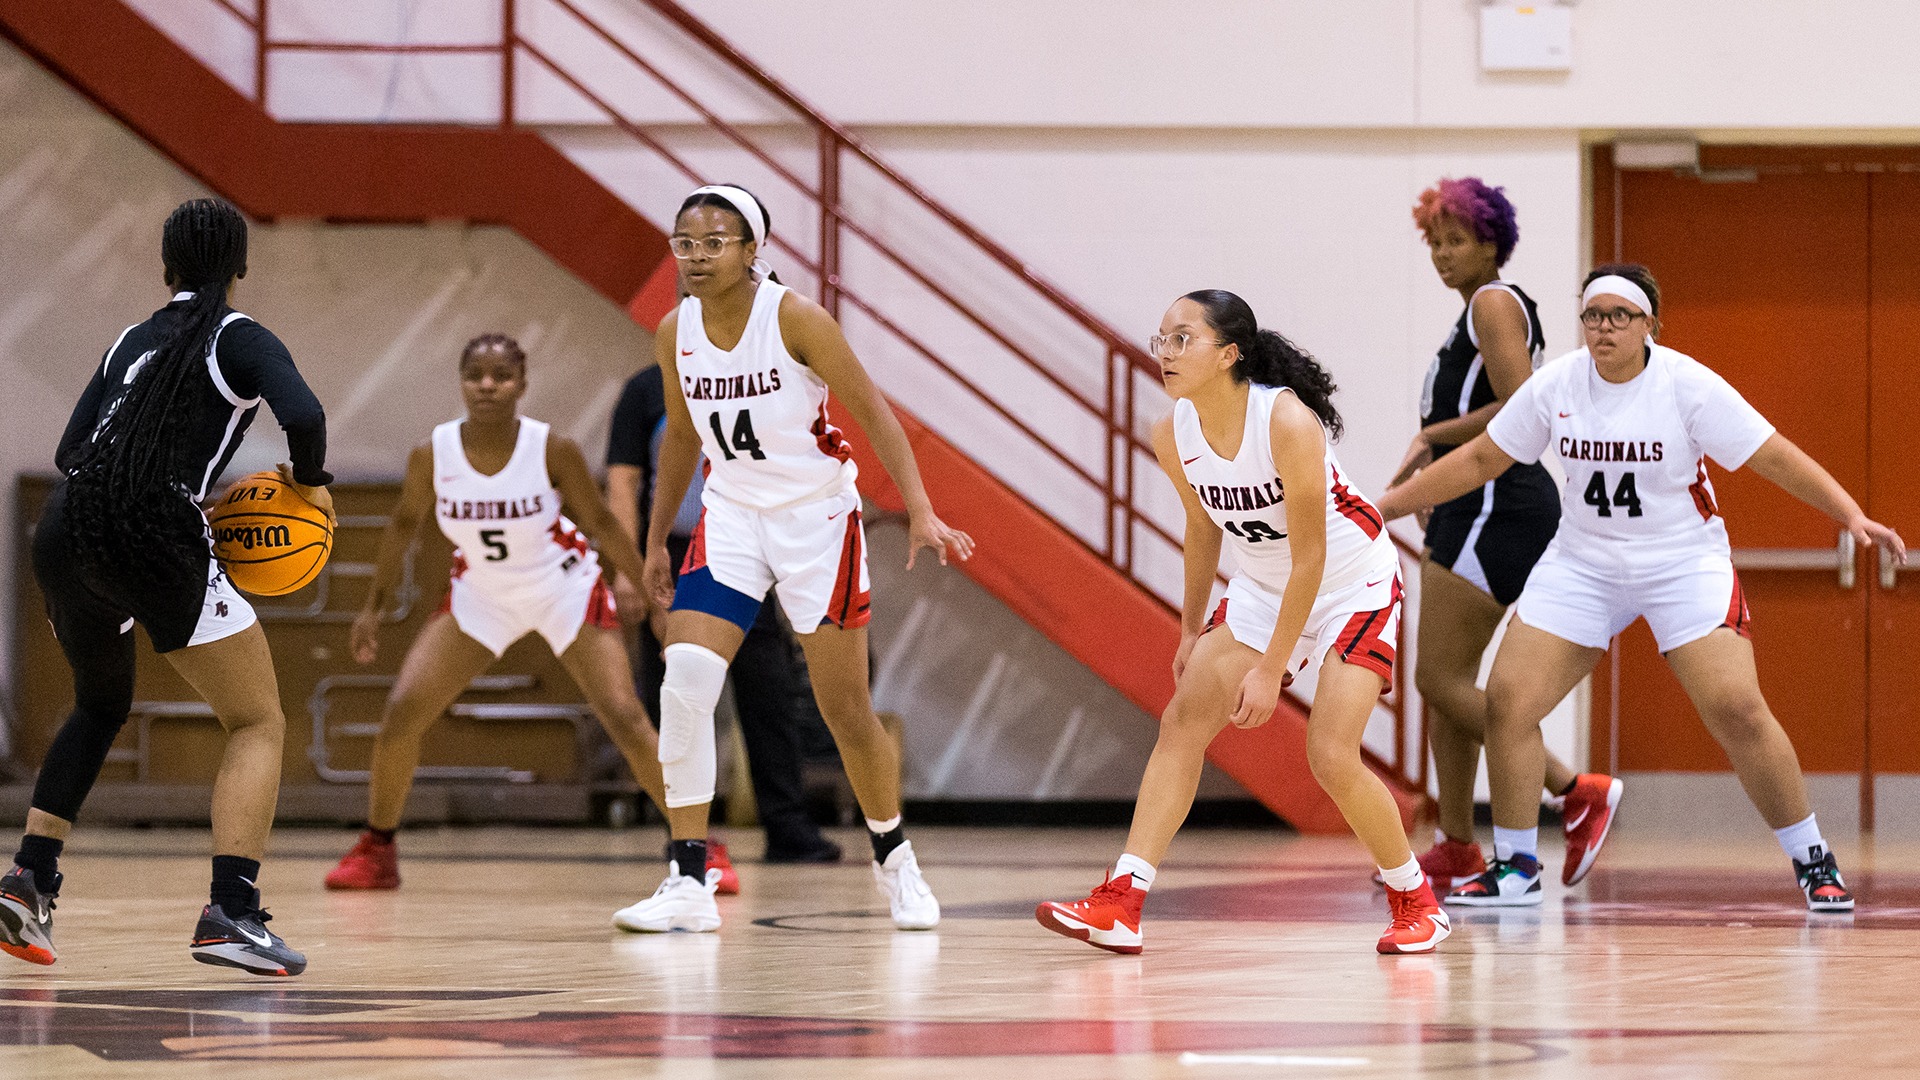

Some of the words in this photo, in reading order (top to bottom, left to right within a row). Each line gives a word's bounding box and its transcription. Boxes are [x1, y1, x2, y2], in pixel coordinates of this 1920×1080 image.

[684, 368, 782, 400] CARDINALS
[709, 408, 767, 461] 14
[1560, 437, 1663, 462] CARDINALS
[438, 495, 544, 520] CARDINALS
[1584, 471, 1643, 518] 44
[479, 529, 509, 561] 5
